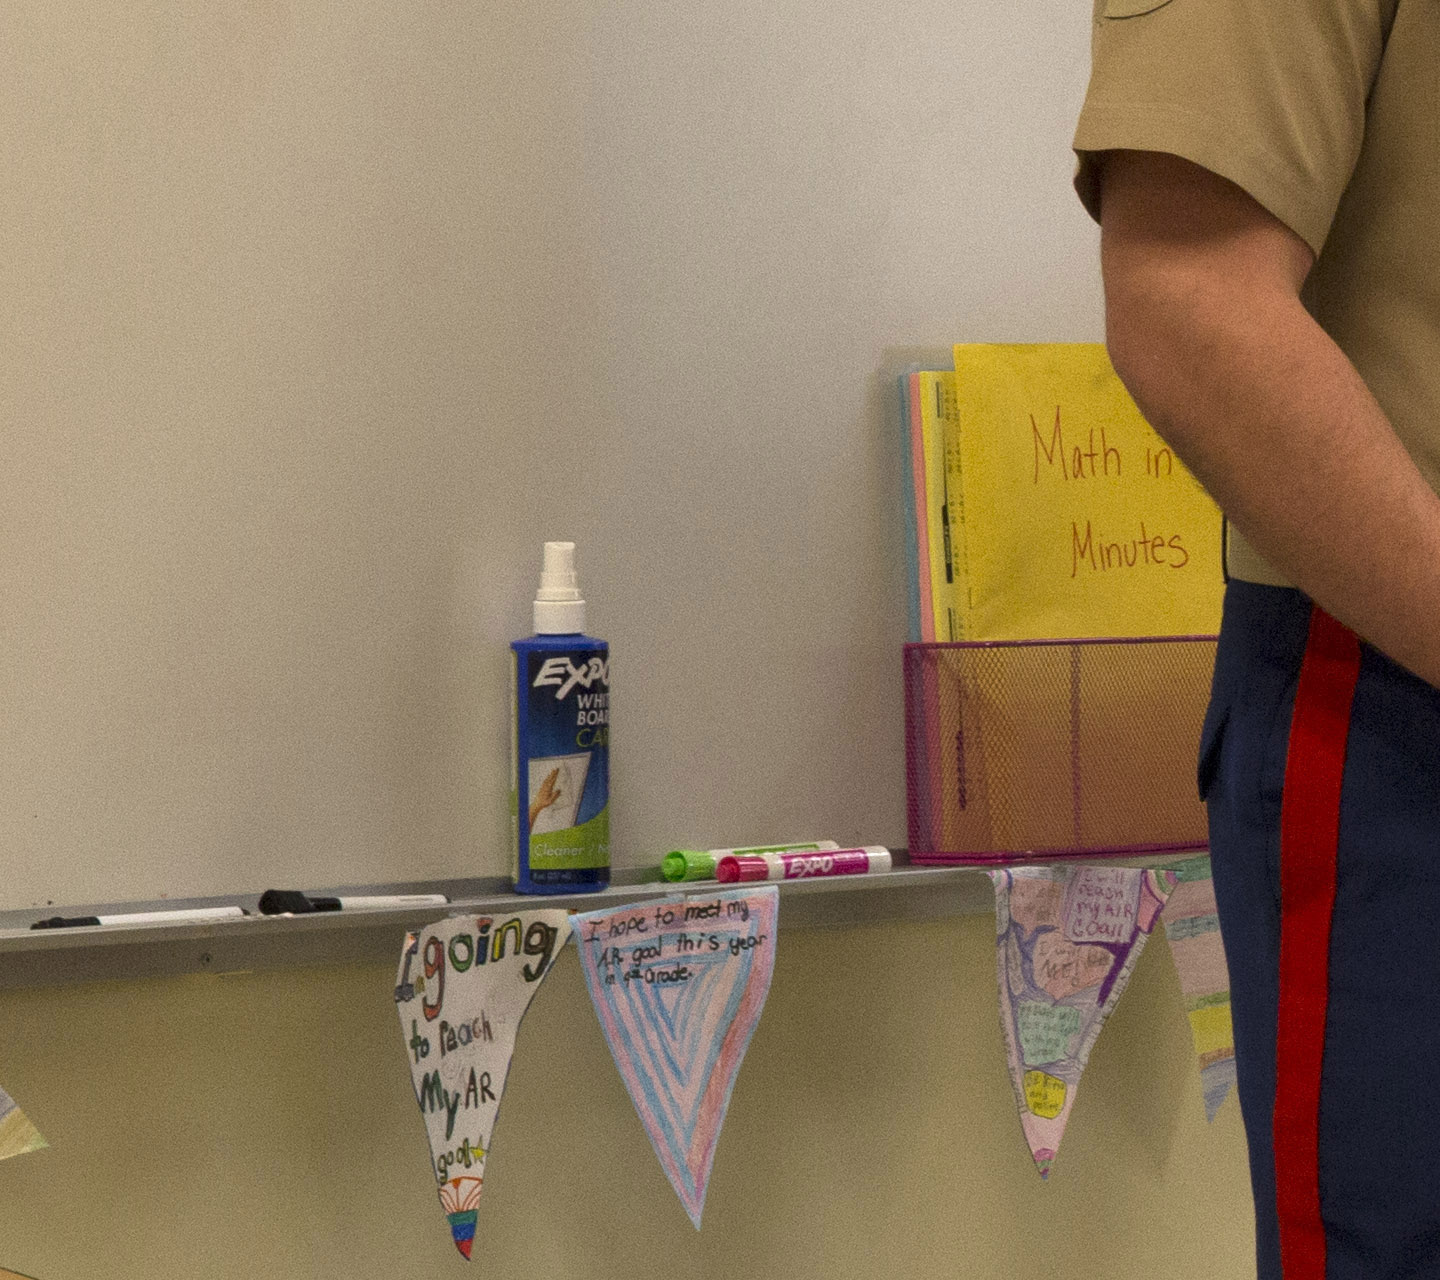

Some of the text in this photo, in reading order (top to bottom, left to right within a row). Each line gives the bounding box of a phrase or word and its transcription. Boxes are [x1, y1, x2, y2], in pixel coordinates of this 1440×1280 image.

[1029, 404, 1173, 484] Math in
[1071, 519, 1190, 578] Minutes
[534, 842, 584, 858] Cleaner
[789, 858, 834, 877] EXPO
[609, 918, 649, 937] hope
[655, 908, 674, 929] to
[685, 900, 722, 921] meet
[727, 901, 748, 922] my
[677, 933, 720, 954] this
[728, 934, 768, 956] year
[423, 916, 558, 1022] going
[410, 1019, 430, 1064] to
[464, 1066, 496, 1110] AR
